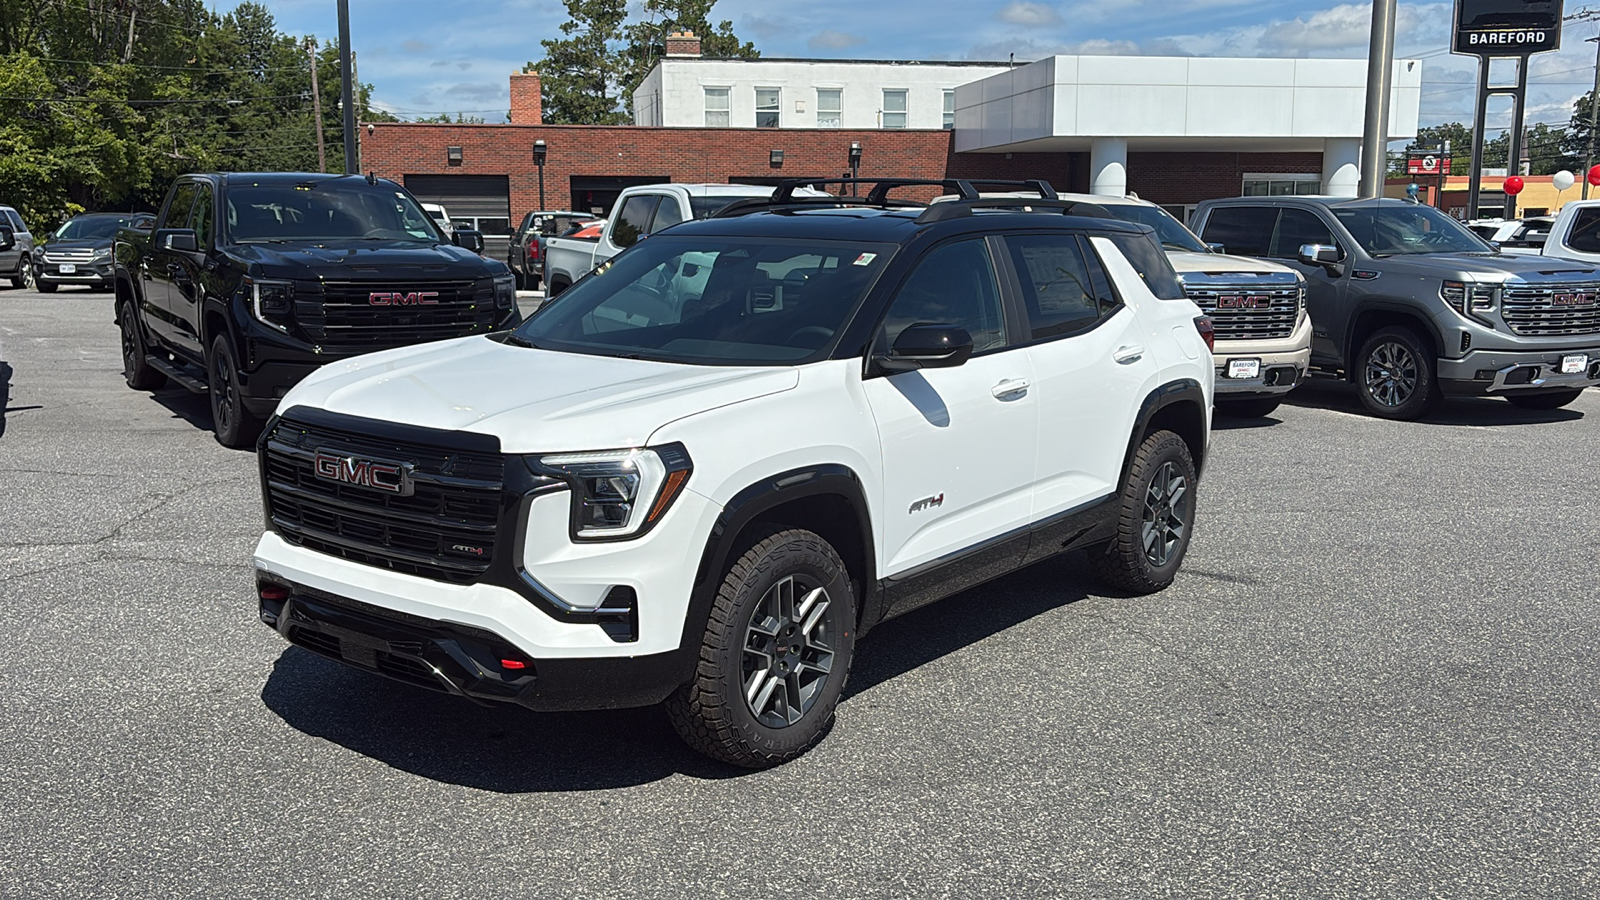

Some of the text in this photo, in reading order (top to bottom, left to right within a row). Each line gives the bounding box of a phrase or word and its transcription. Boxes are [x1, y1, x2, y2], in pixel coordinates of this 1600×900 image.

[1469, 32, 1546, 44] BAREFORD
[369, 292, 439, 306] GMC
[1219, 295, 1269, 308] GMC
[1554, 293, 1595, 306] GMC
[315, 454, 400, 492] GMC
[908, 493, 944, 515] AT4
